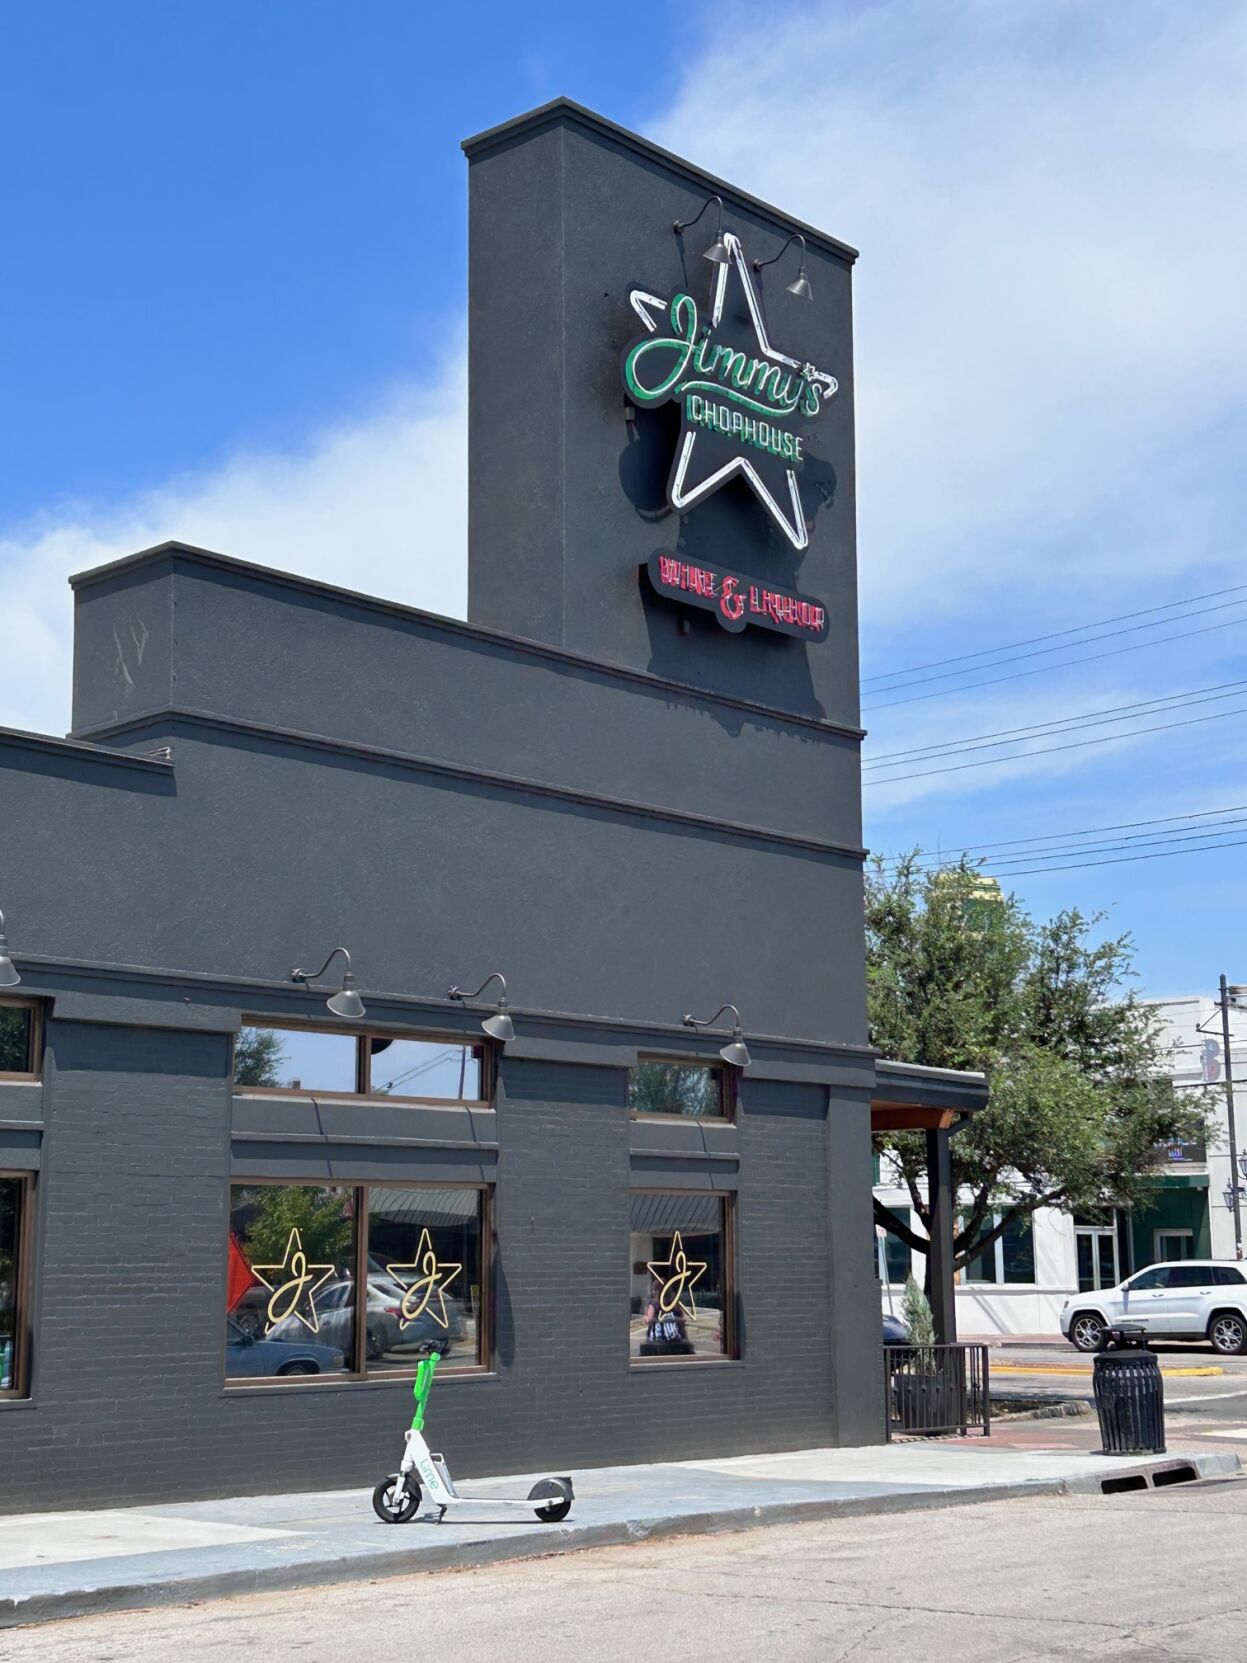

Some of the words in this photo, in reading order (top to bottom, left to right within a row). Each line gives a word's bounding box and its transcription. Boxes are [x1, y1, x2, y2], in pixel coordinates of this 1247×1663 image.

[686, 394, 804, 462] CHOPHOUSE
[659, 556, 718, 599] WINE
[720, 575, 747, 620] &
[749, 585, 825, 632] LIQUOR
